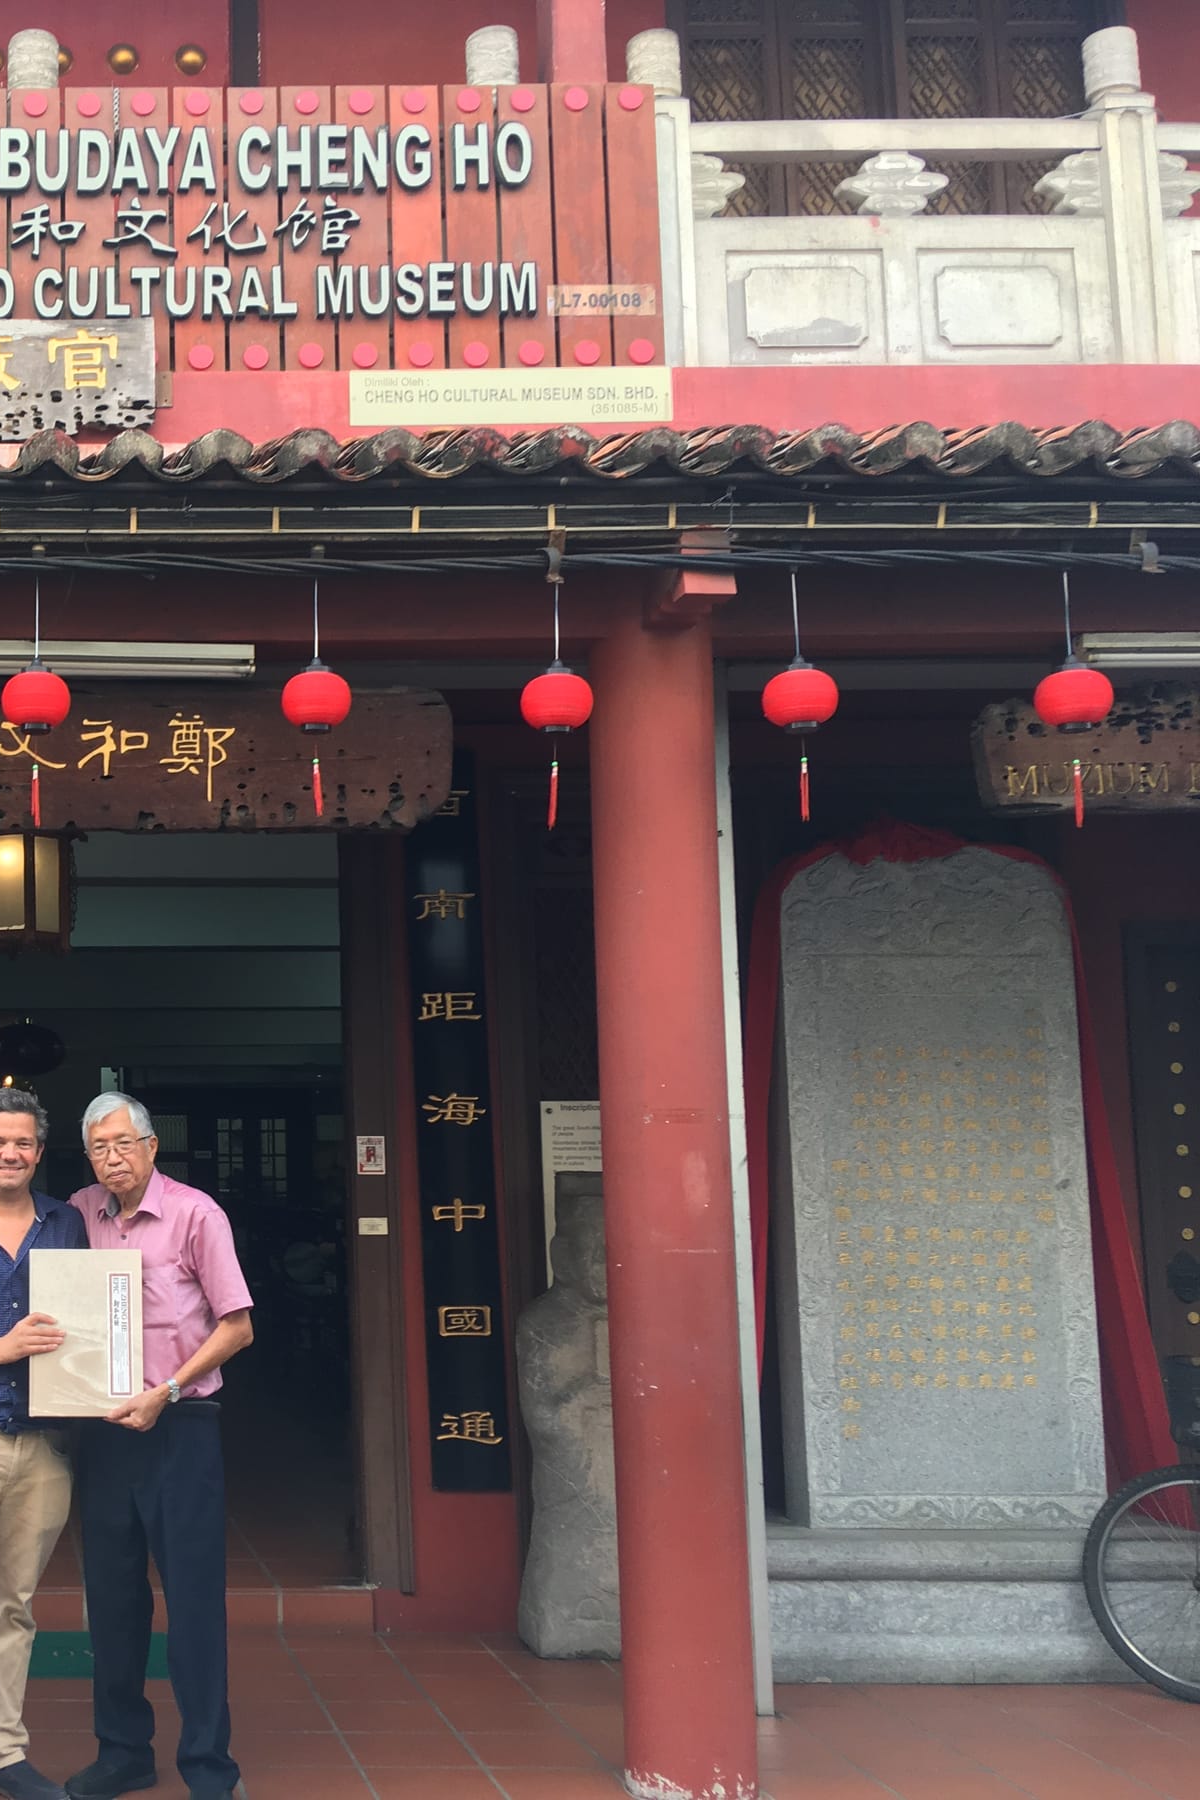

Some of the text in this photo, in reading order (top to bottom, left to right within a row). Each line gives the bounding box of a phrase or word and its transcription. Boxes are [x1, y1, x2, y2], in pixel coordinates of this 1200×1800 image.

[237, 122, 433, 192] CHENG
[453, 121, 533, 191] HO
[32, 264, 298, 320] CULTURAL
[315, 261, 537, 320] MUSEUM
[561, 292, 642, 309] L7.00108
[364, 386, 659, 404] CHENG HO CULTURAL MUSEUM SDN. BHD.
[1006, 760, 1171, 797] MUZIUM
[560, 1104, 601, 1112] Inscriptio
